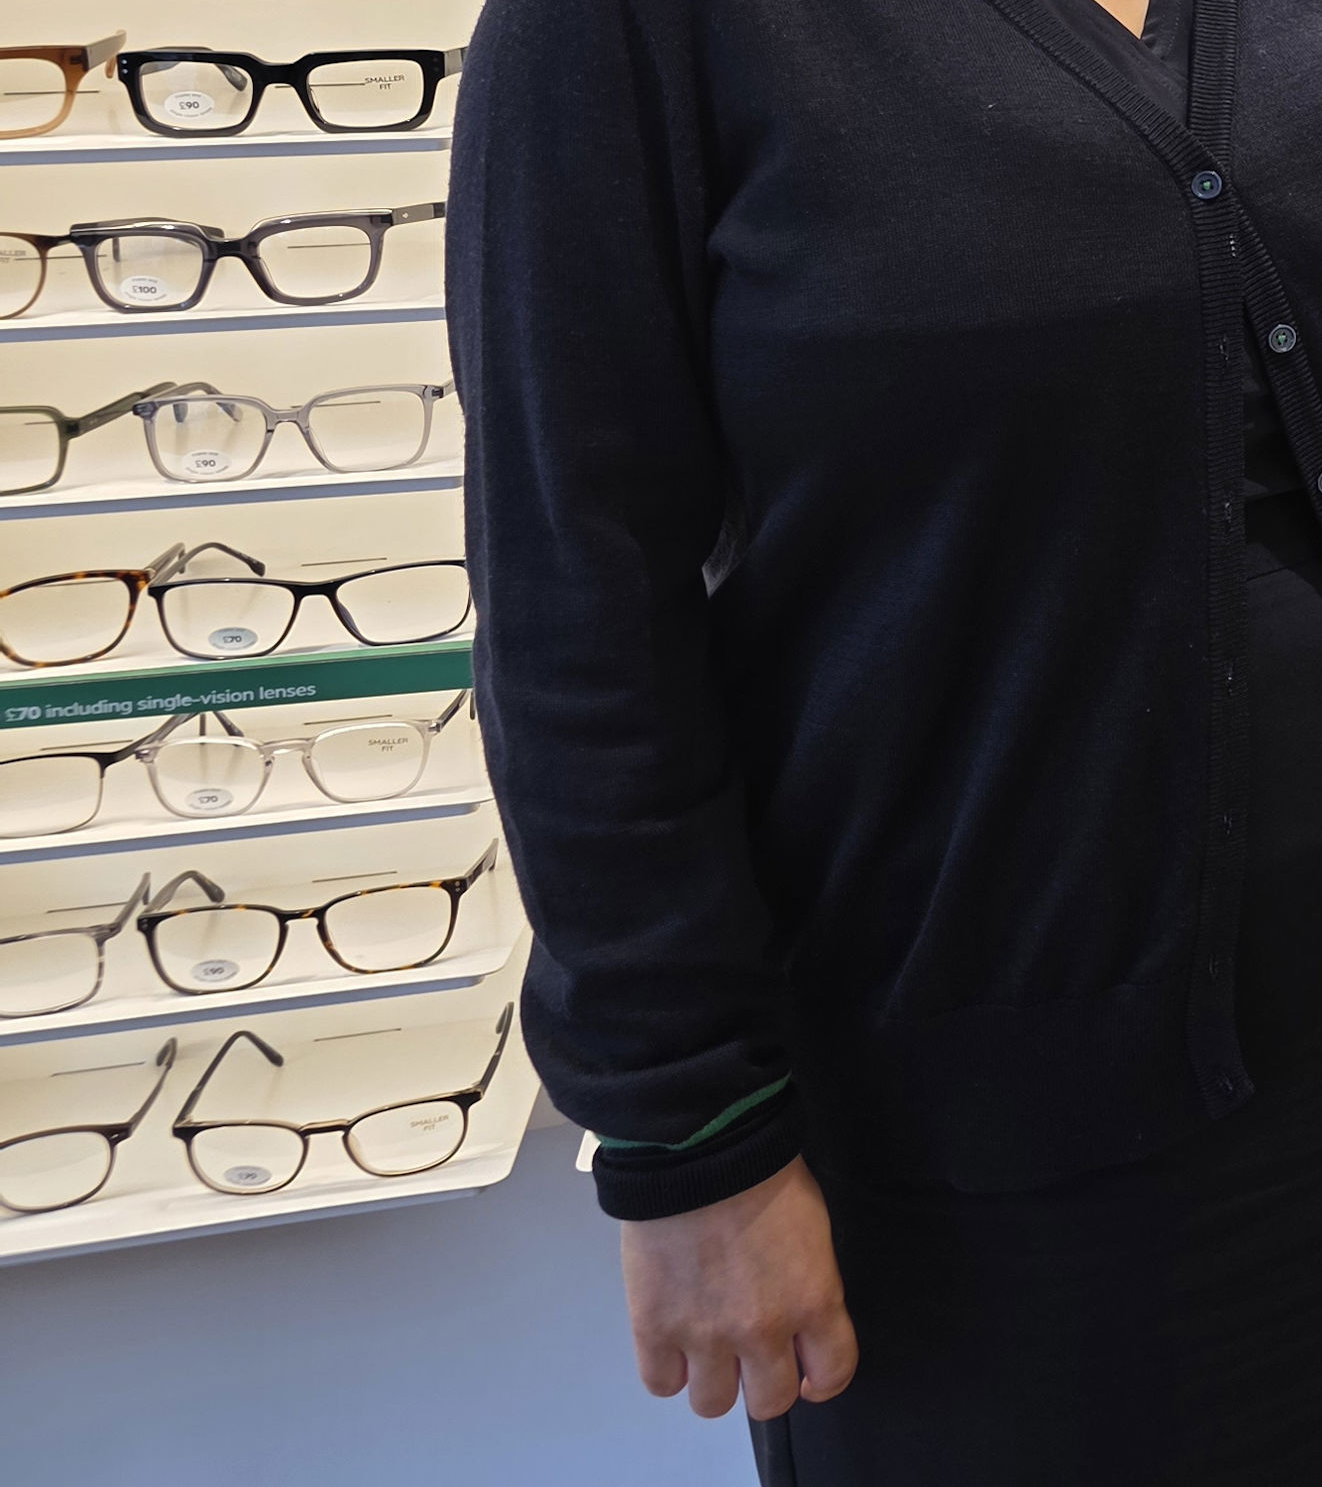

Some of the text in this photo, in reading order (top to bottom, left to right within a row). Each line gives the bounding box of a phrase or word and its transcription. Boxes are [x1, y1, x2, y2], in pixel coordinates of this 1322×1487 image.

[364, 75, 405, 84] SMALLER
[179, 101, 200, 110] £90
[132, 284, 157, 294] £100
[195, 458, 216, 468] £90
[5, 684, 317, 722] £70 including single-vision lenses
